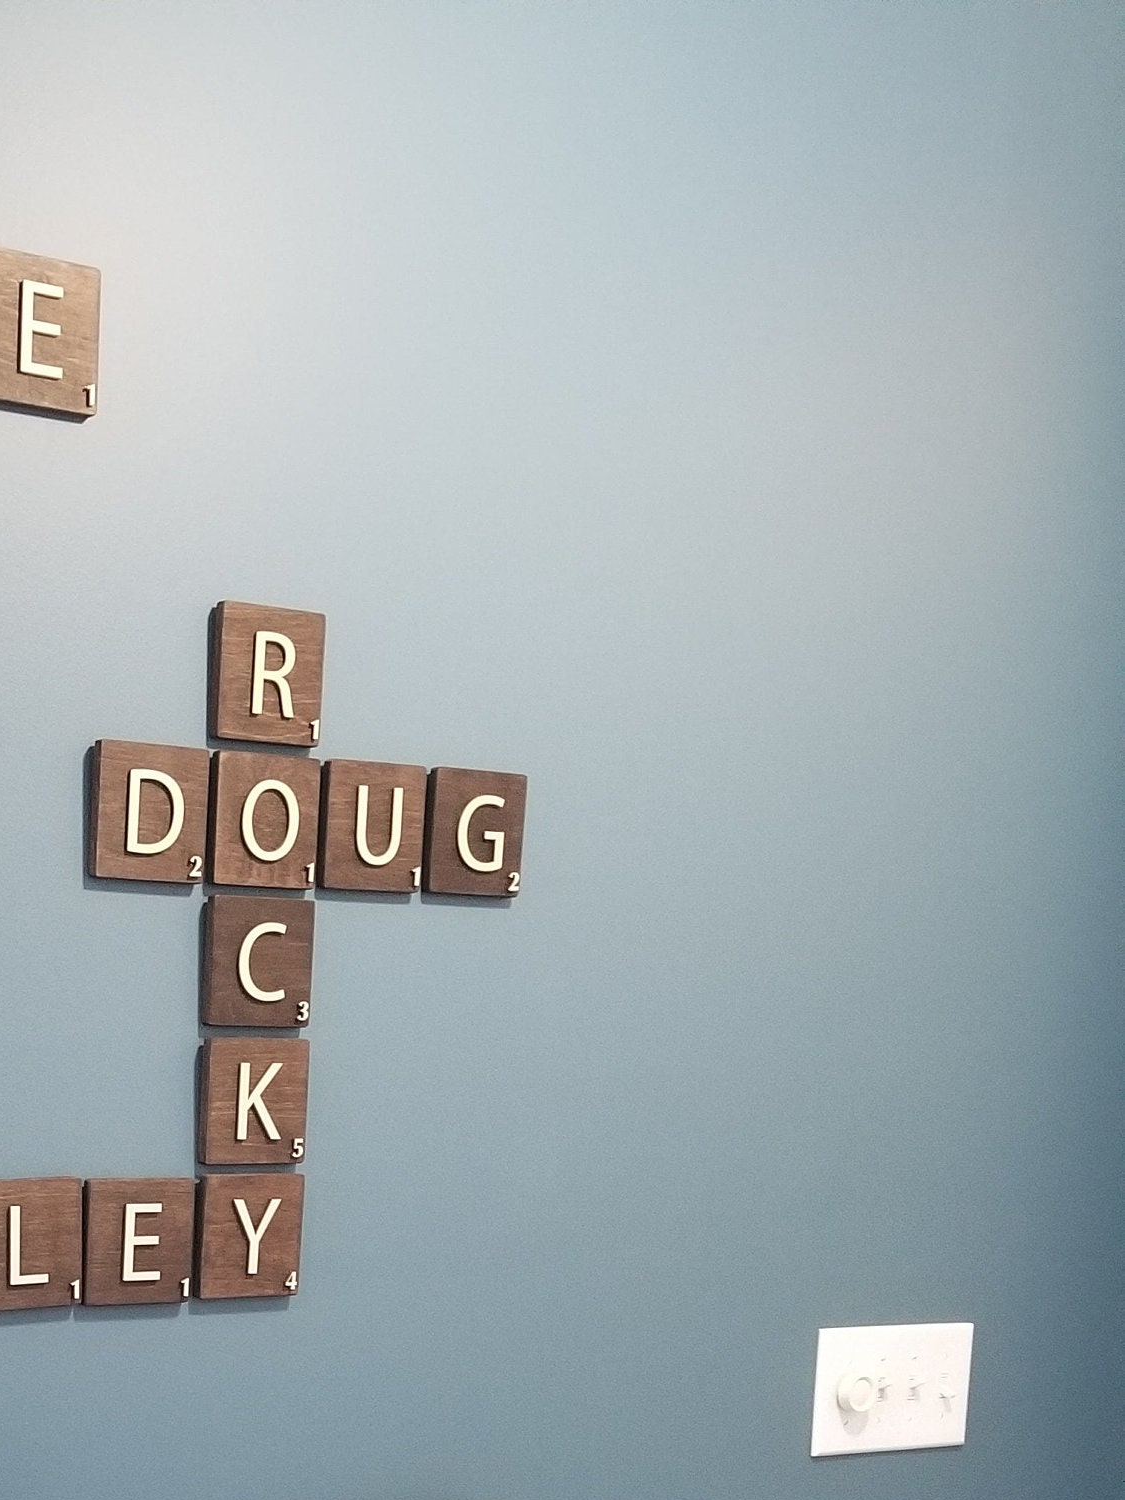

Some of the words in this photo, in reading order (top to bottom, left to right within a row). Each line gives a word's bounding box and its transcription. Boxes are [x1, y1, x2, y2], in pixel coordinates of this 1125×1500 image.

[85, 383, 96, 407] 1
[309, 718, 321, 740] 1
[126, 768, 506, 873] DOUG
[189, 855, 203, 878] 2
[305, 862, 316, 884] 1
[411, 866, 422, 887] 1
[507, 871, 521, 892] 2
[233, 630, 300, 1276] ROCKY
[296, 1001, 310, 1021] 3
[291, 1137, 304, 1158] 5
[69, 1279, 81, 1299] 1
[179, 1277, 190, 1298] 1
[285, 1271, 298, 1290] 4
